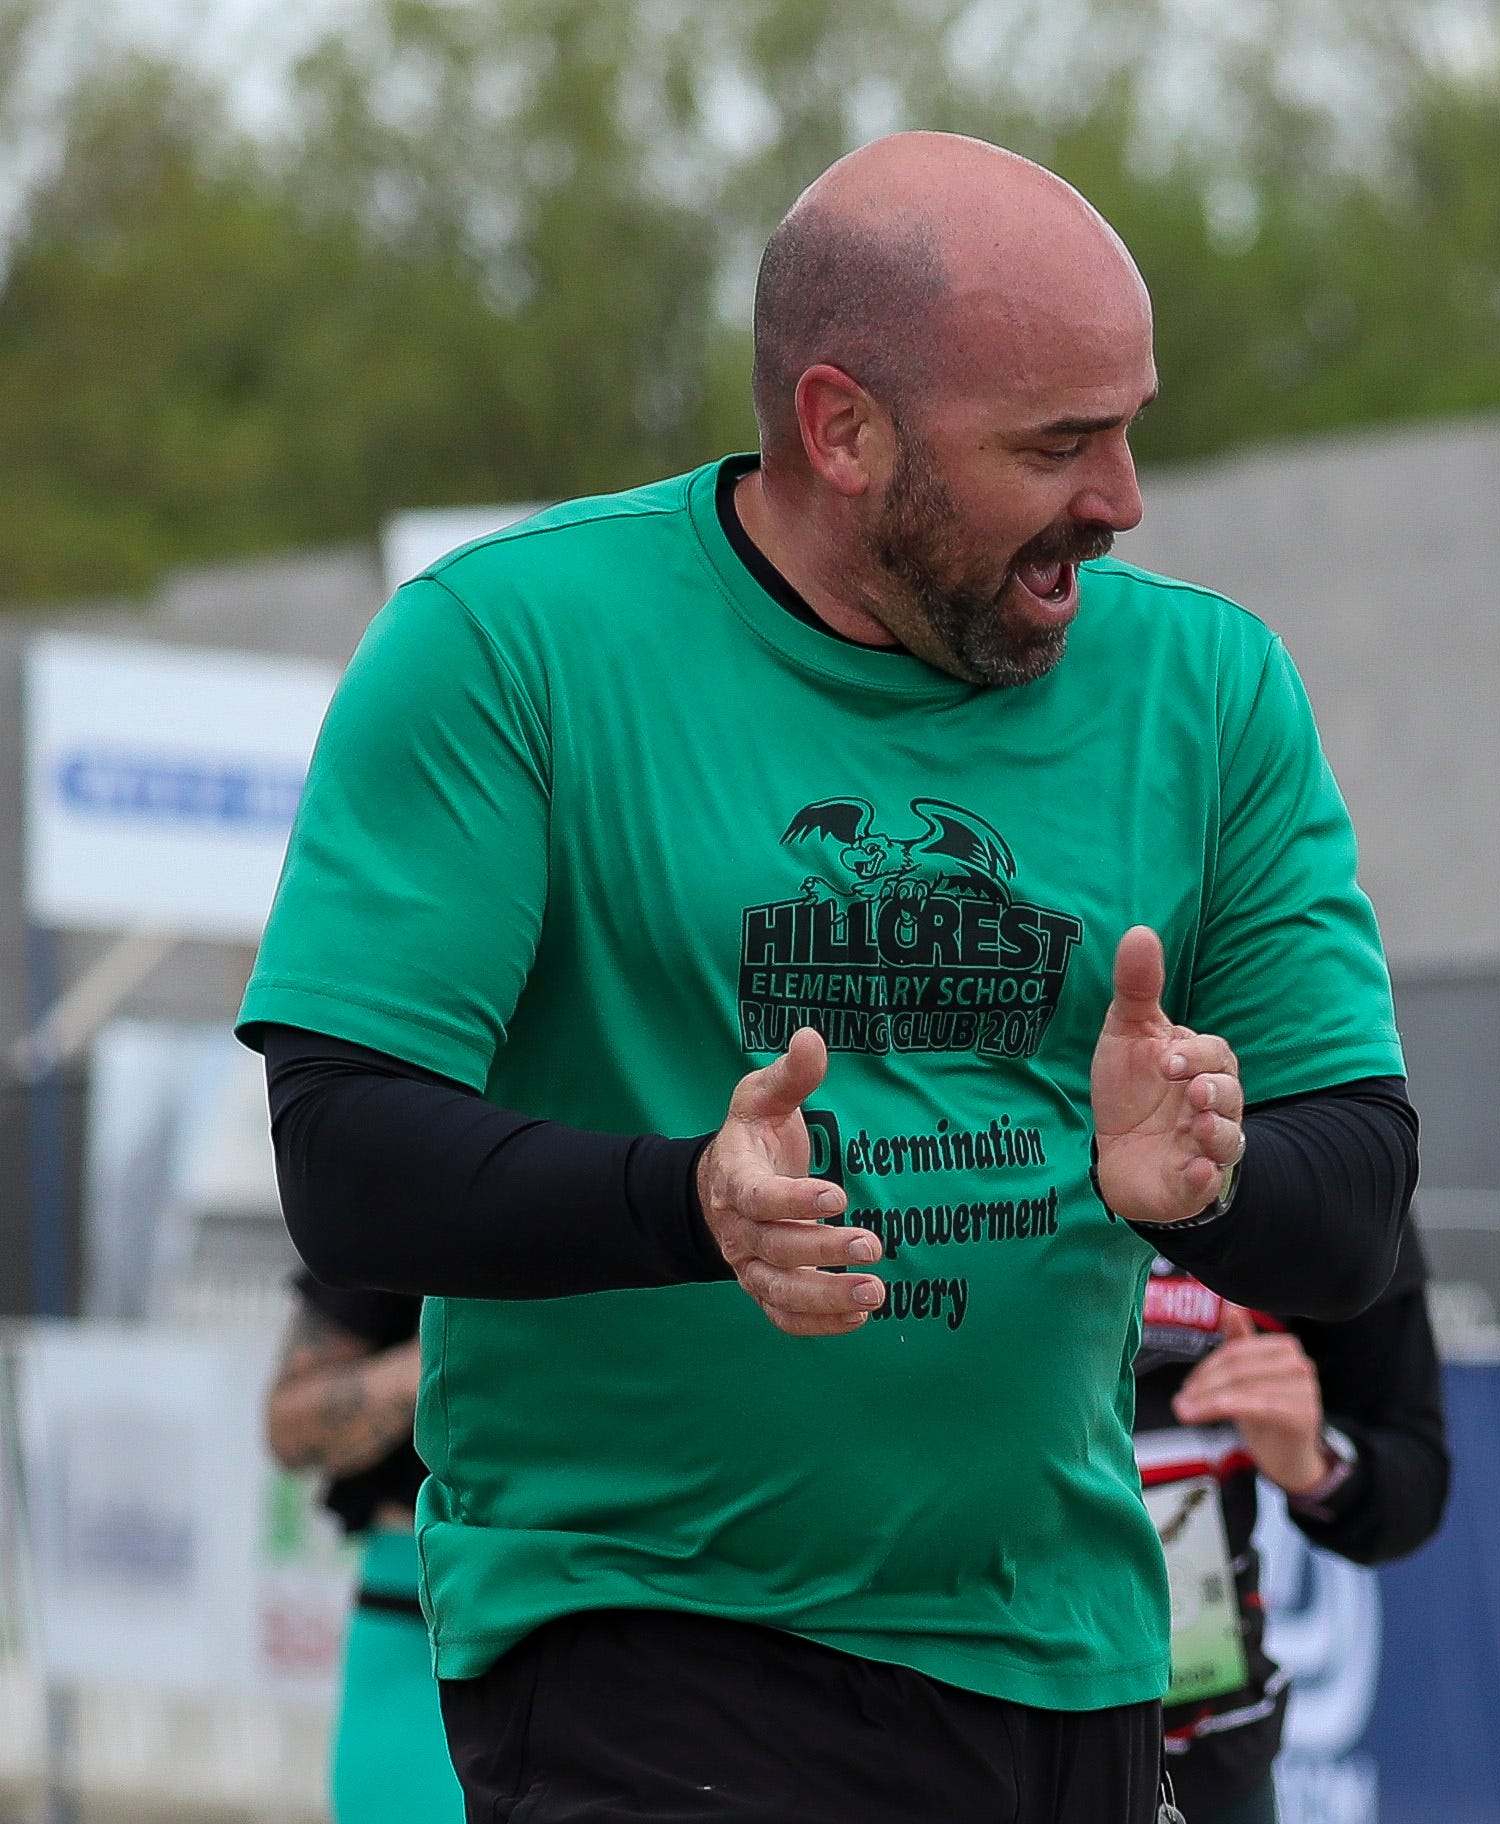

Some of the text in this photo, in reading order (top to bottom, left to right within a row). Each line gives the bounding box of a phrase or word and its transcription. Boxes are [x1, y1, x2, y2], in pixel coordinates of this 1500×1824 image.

[743, 899, 1083, 975] HILLCREST
[752, 972, 1048, 1008] ELEMENTARY SCHOOL
[740, 1001, 890, 1053] RUNNING
[892, 1012, 978, 1050] CLUB
[824, 1186, 1058, 1260] mpowerment
